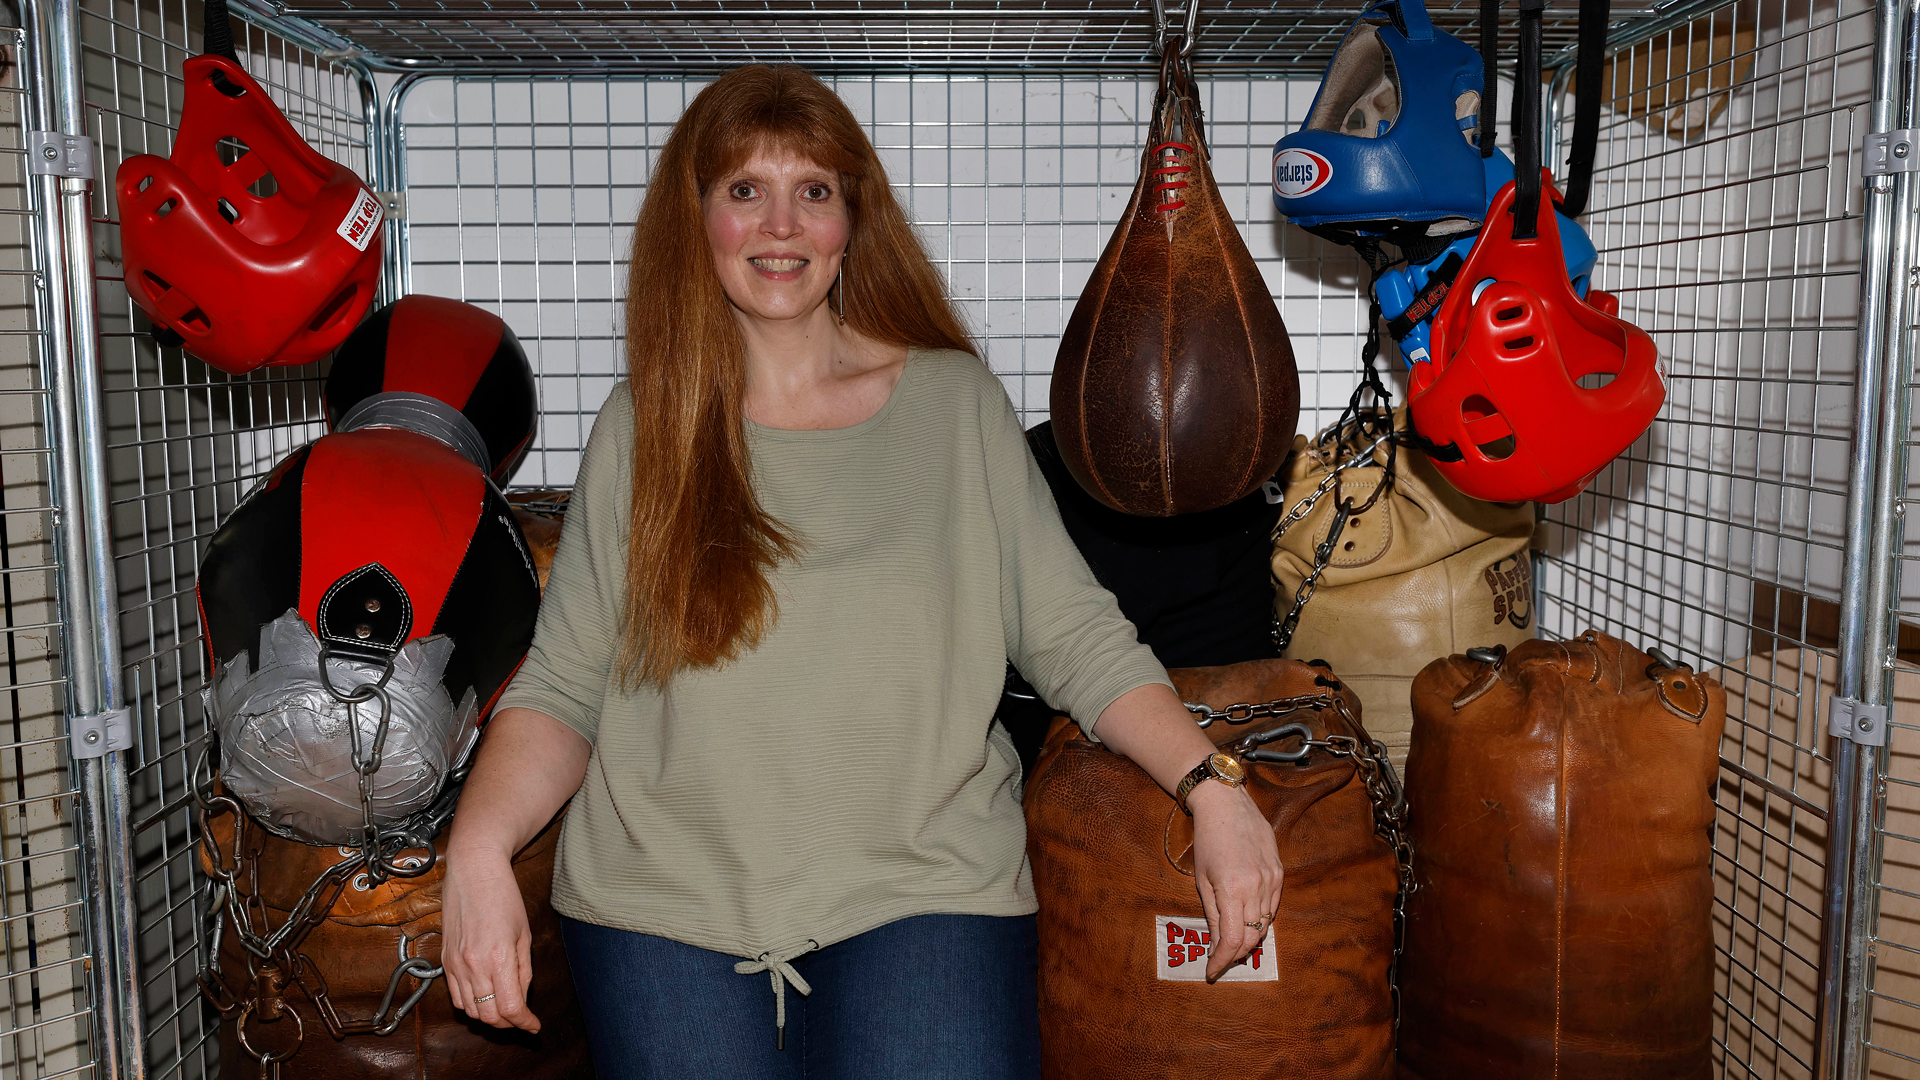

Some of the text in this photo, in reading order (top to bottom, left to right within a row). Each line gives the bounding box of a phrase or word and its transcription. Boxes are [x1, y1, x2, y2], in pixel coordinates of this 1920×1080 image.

[1276, 162, 1312, 185] starpak
[347, 197, 377, 242] TOP TEN
[1406, 282, 1450, 322] TOP TEN
[1493, 578, 1532, 625] SPOR
[1167, 944, 1263, 970] SPT
